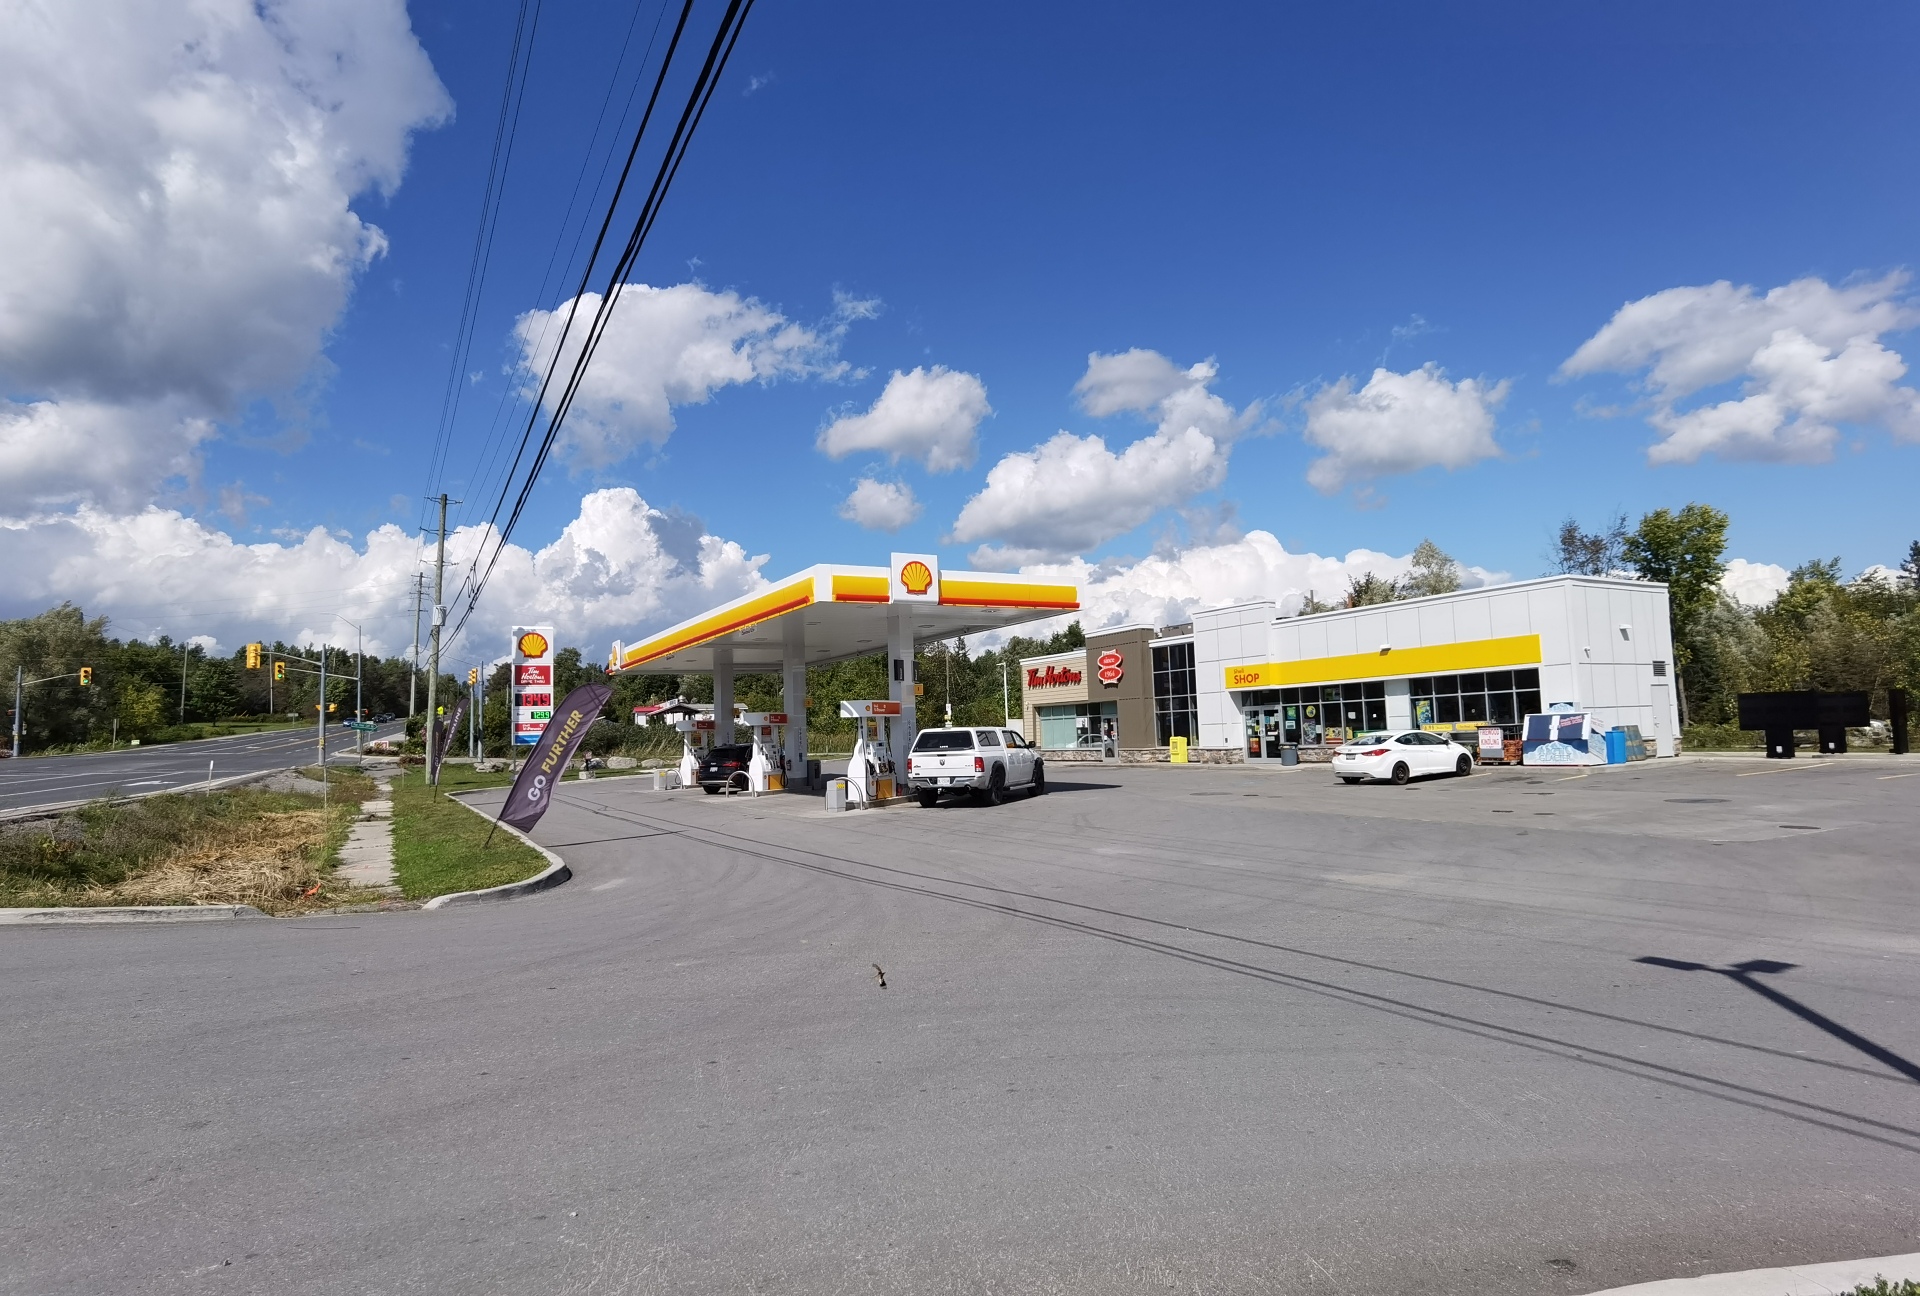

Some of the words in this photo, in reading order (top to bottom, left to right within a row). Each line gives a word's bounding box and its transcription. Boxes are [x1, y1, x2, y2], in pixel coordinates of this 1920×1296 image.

[1027, 668, 1044, 687] Tim
[1044, 666, 1081, 685] Hortons
[1234, 673, 1260, 684] SHOP
[533, 711, 550, 719] 129.9
[527, 775, 546, 801] GO
[541, 709, 584, 774] FURTHER
